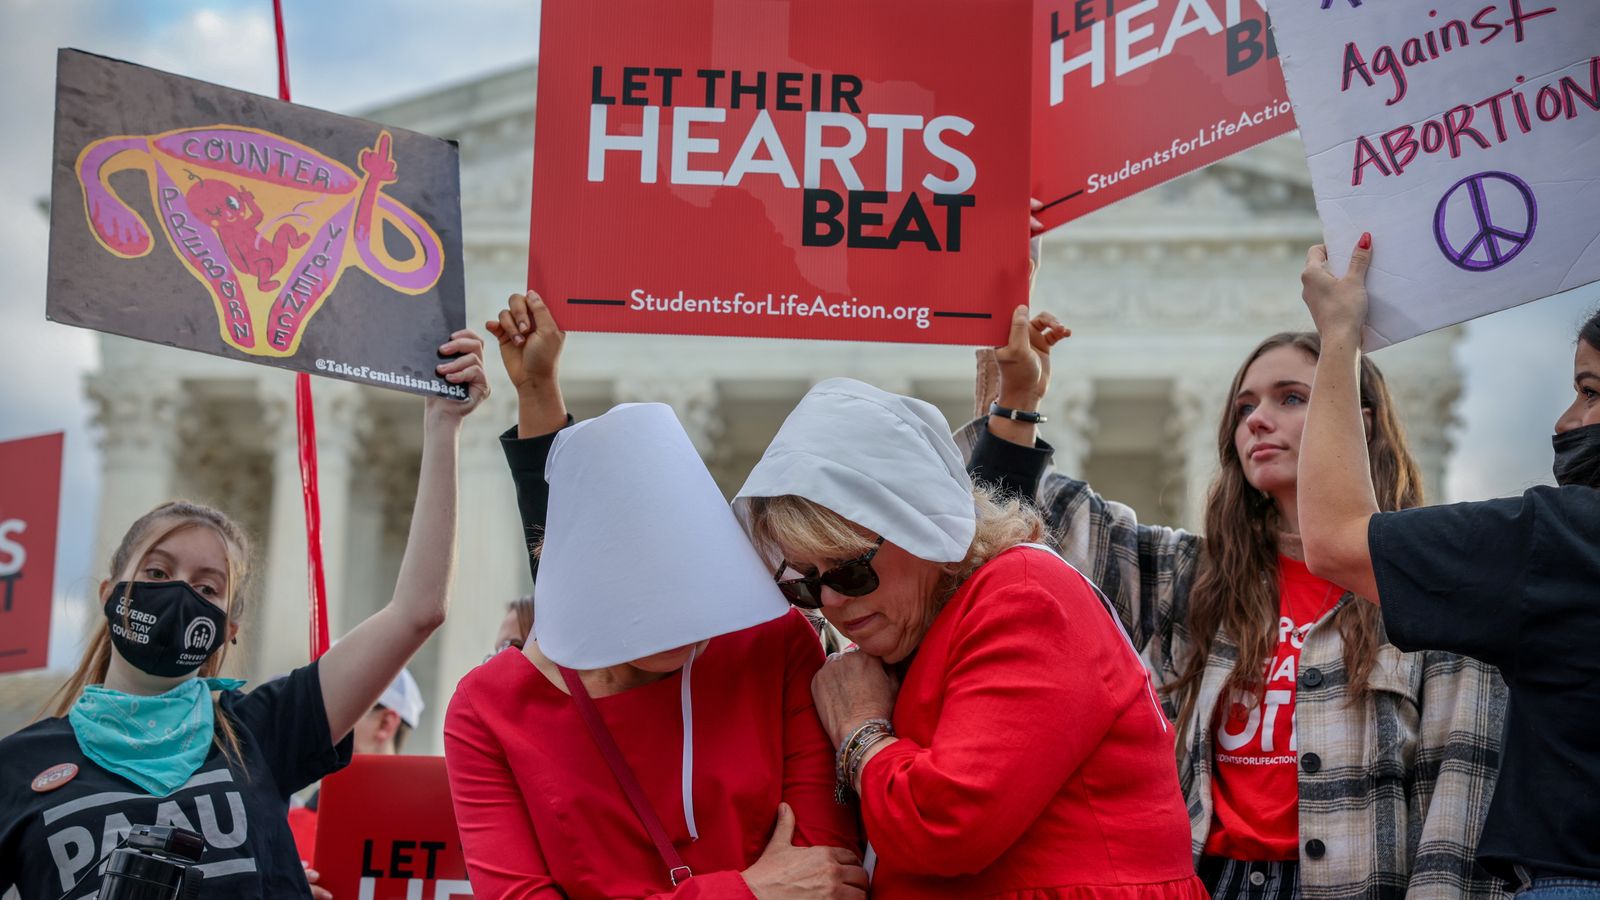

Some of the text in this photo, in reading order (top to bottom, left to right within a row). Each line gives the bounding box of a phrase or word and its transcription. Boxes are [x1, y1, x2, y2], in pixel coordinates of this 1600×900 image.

[1341, 0, 1557, 106] Against
[591, 66, 863, 114] LET THEIR
[1352, 56, 1600, 186] ABORTION
[182, 137, 331, 188] COUNTER
[587, 103, 977, 195] HEARTS
[802, 188, 975, 252] BEAT
[162, 188, 249, 339] PREBORN
[273, 222, 344, 346] VIOLENCE
[630, 289, 930, 328] StudentsforLifeAction.org
[315, 358, 466, 397] @TakeFeminismBack
[112, 624, 149, 644] COVERED
[130, 622, 151, 633] STAY
[361, 839, 446, 879] LET
